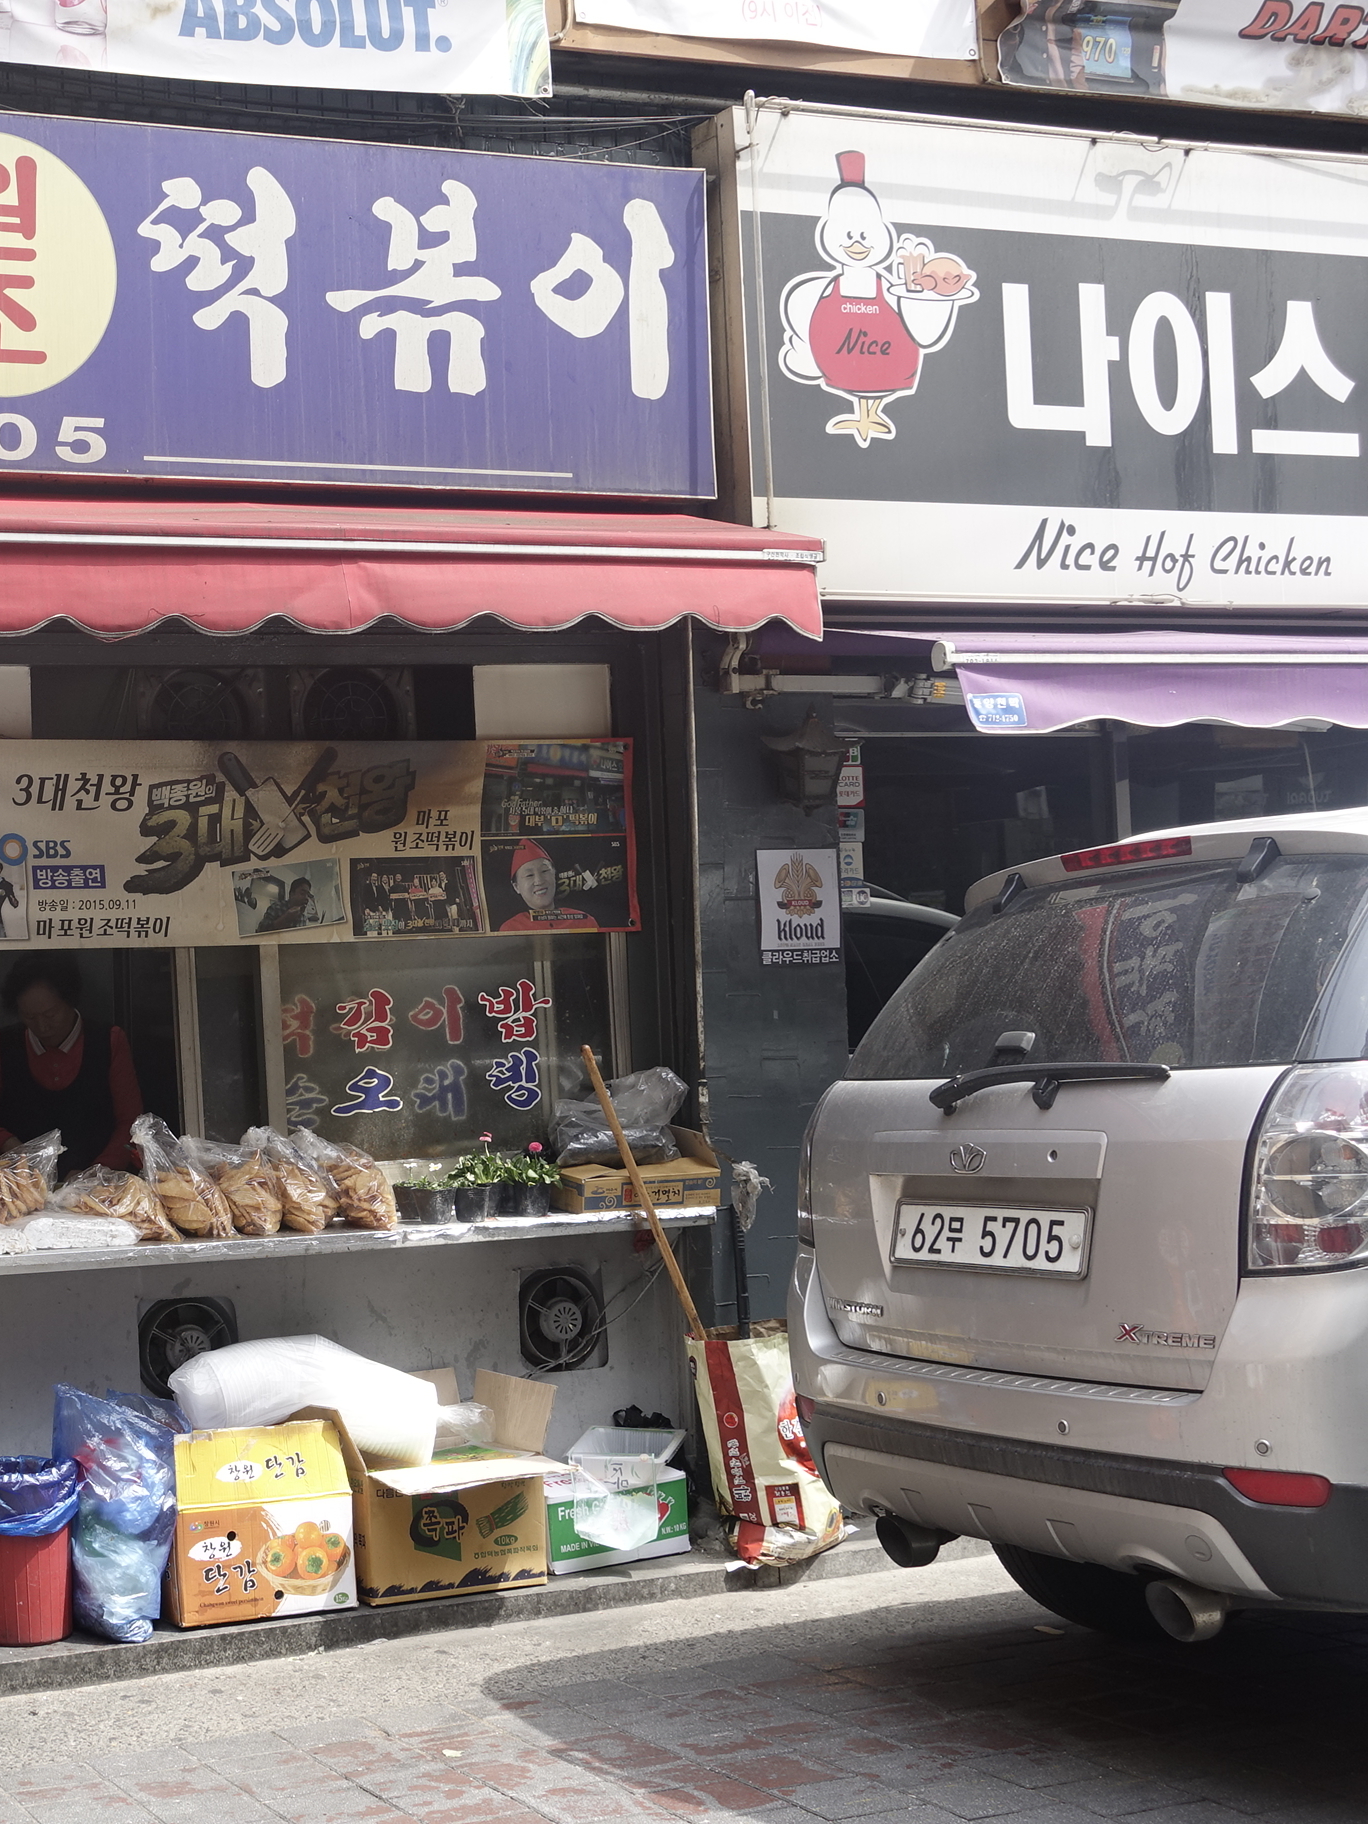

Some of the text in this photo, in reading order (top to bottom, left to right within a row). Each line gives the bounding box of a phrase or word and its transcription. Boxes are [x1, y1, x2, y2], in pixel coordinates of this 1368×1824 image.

[1082, 35, 1116, 64] 970
[137, 165, 675, 401] 떡볶이
[840, 301, 880, 315] chicken
[835, 326, 892, 358] Nice
[1001, 282, 1360, 458] 나이스
[1013, 516, 1333, 593] Nice Hof Chicken
[12, 772, 144, 813] 3대천왕
[151, 779, 218, 807] 백종원의
[415, 808, 450, 829] 마포
[32, 840, 72, 859] SBS
[391, 830, 475, 852] 원조떡볶이
[36, 868, 103, 888] 방송출연
[37, 899, 137, 912] 방송일 2015.09.11
[35, 916, 171, 940] 마포원조떡볶이
[762, 950, 840, 965] 클라우드취급업소
[651, 1187, 681, 1203] 건멸치
[910, 1212, 1066, 1263] 62무 5705
[227, 1452, 307, 1481] 창원 단감
[421, 1505, 468, 1543] 쪽파
[201, 1540, 233, 1560] 창원
[560, 1541, 588, 1554] MADE IN
[202, 1559, 259, 1597] 단감
